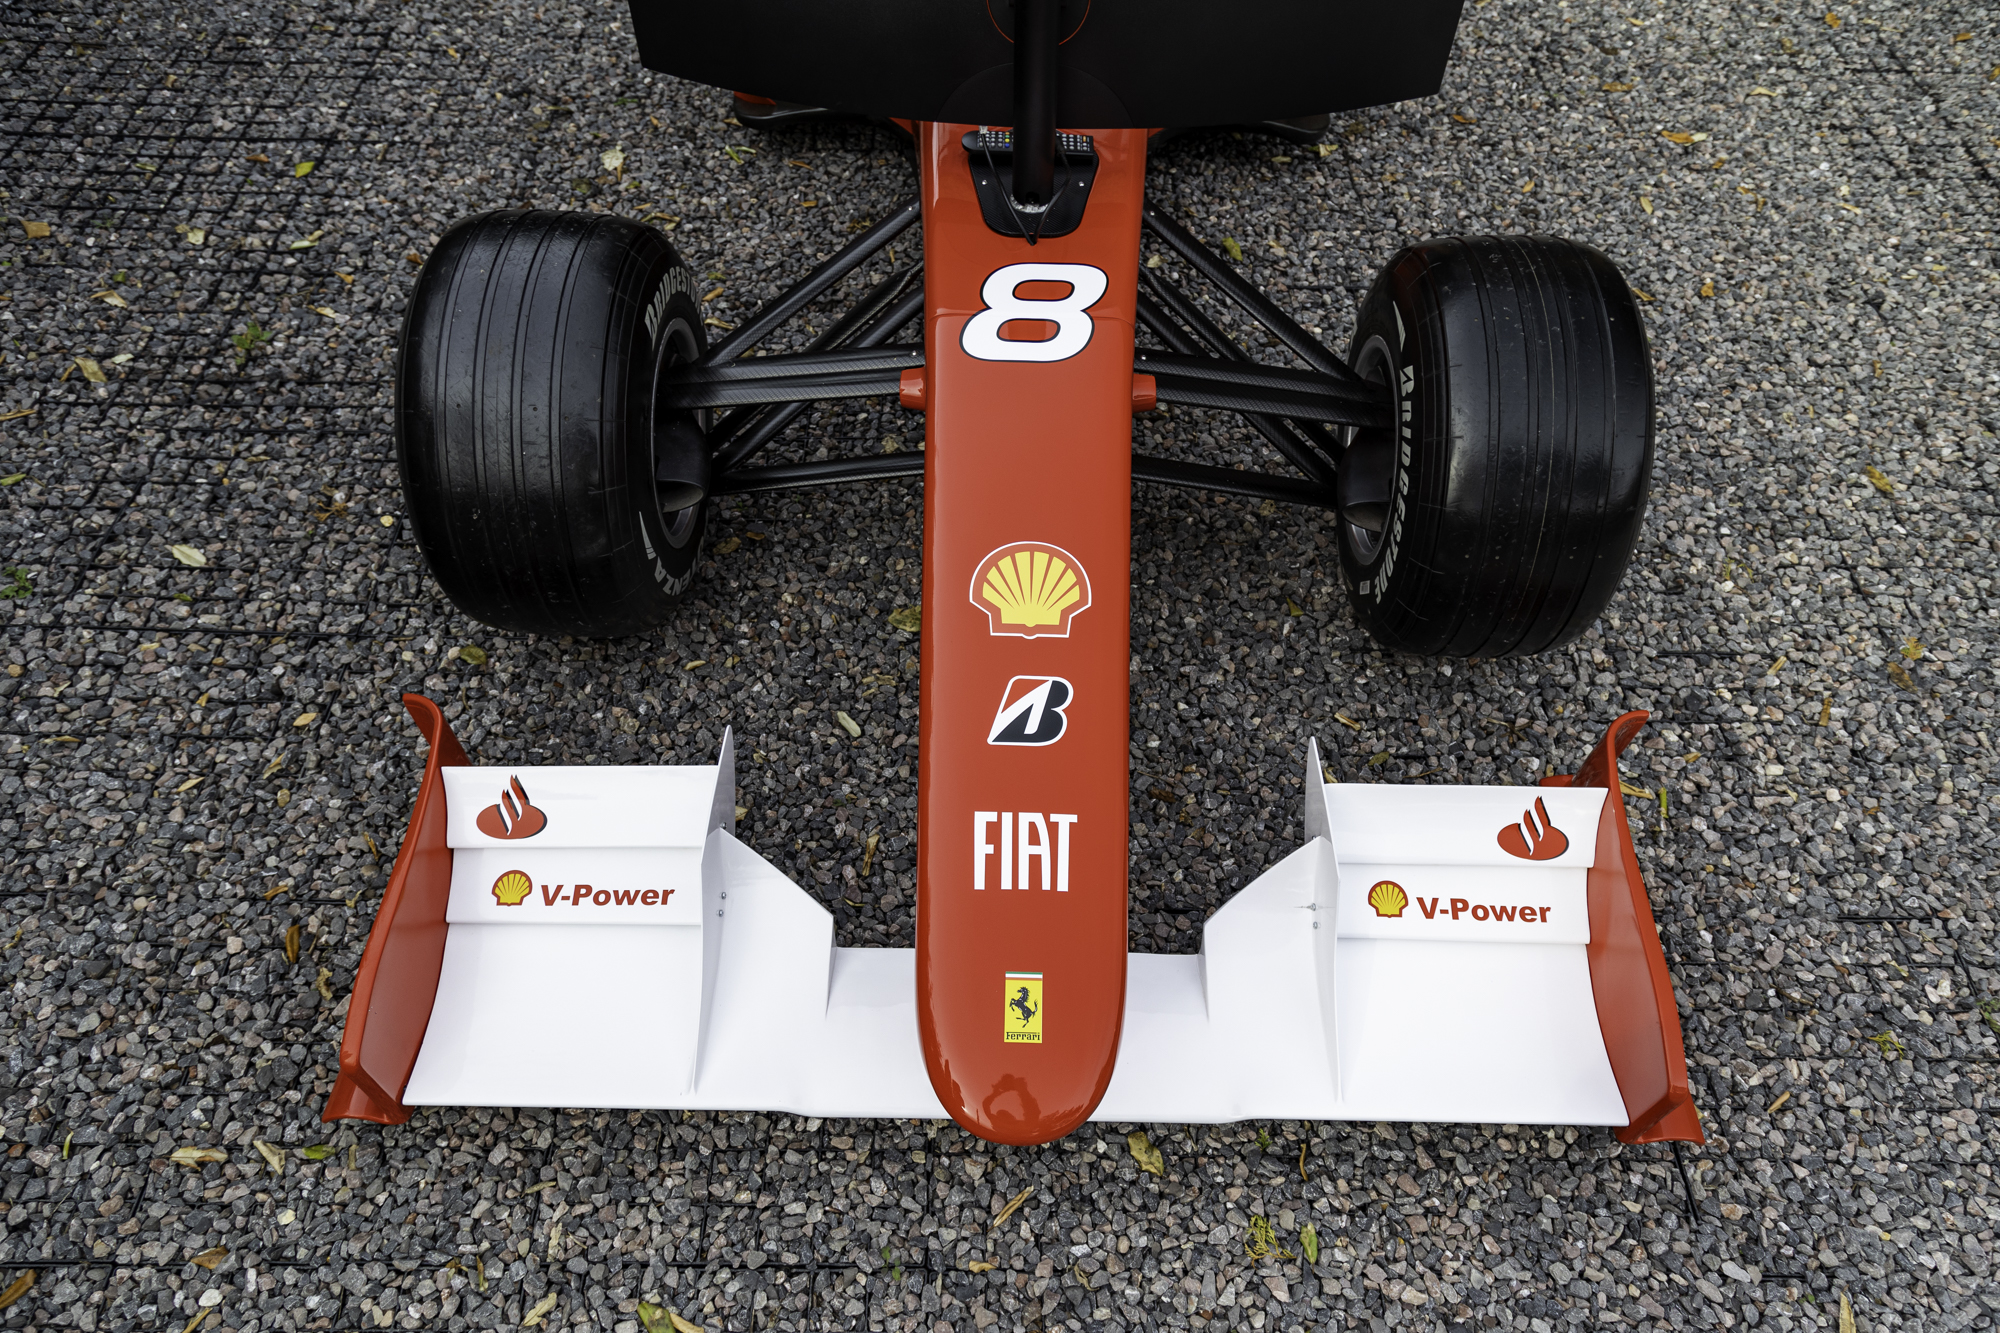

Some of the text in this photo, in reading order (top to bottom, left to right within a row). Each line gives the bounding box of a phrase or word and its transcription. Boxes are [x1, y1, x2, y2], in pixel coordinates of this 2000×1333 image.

[960, 262, 1108, 362] 8
[1375, 365, 1415, 605] BRIDGESTONE
[974, 811, 1078, 892] FIAT
[541, 884, 675, 907] V-Power
[1416, 897, 1551, 923] V-Power
[1005, 1031, 1041, 1041] Ferrari
